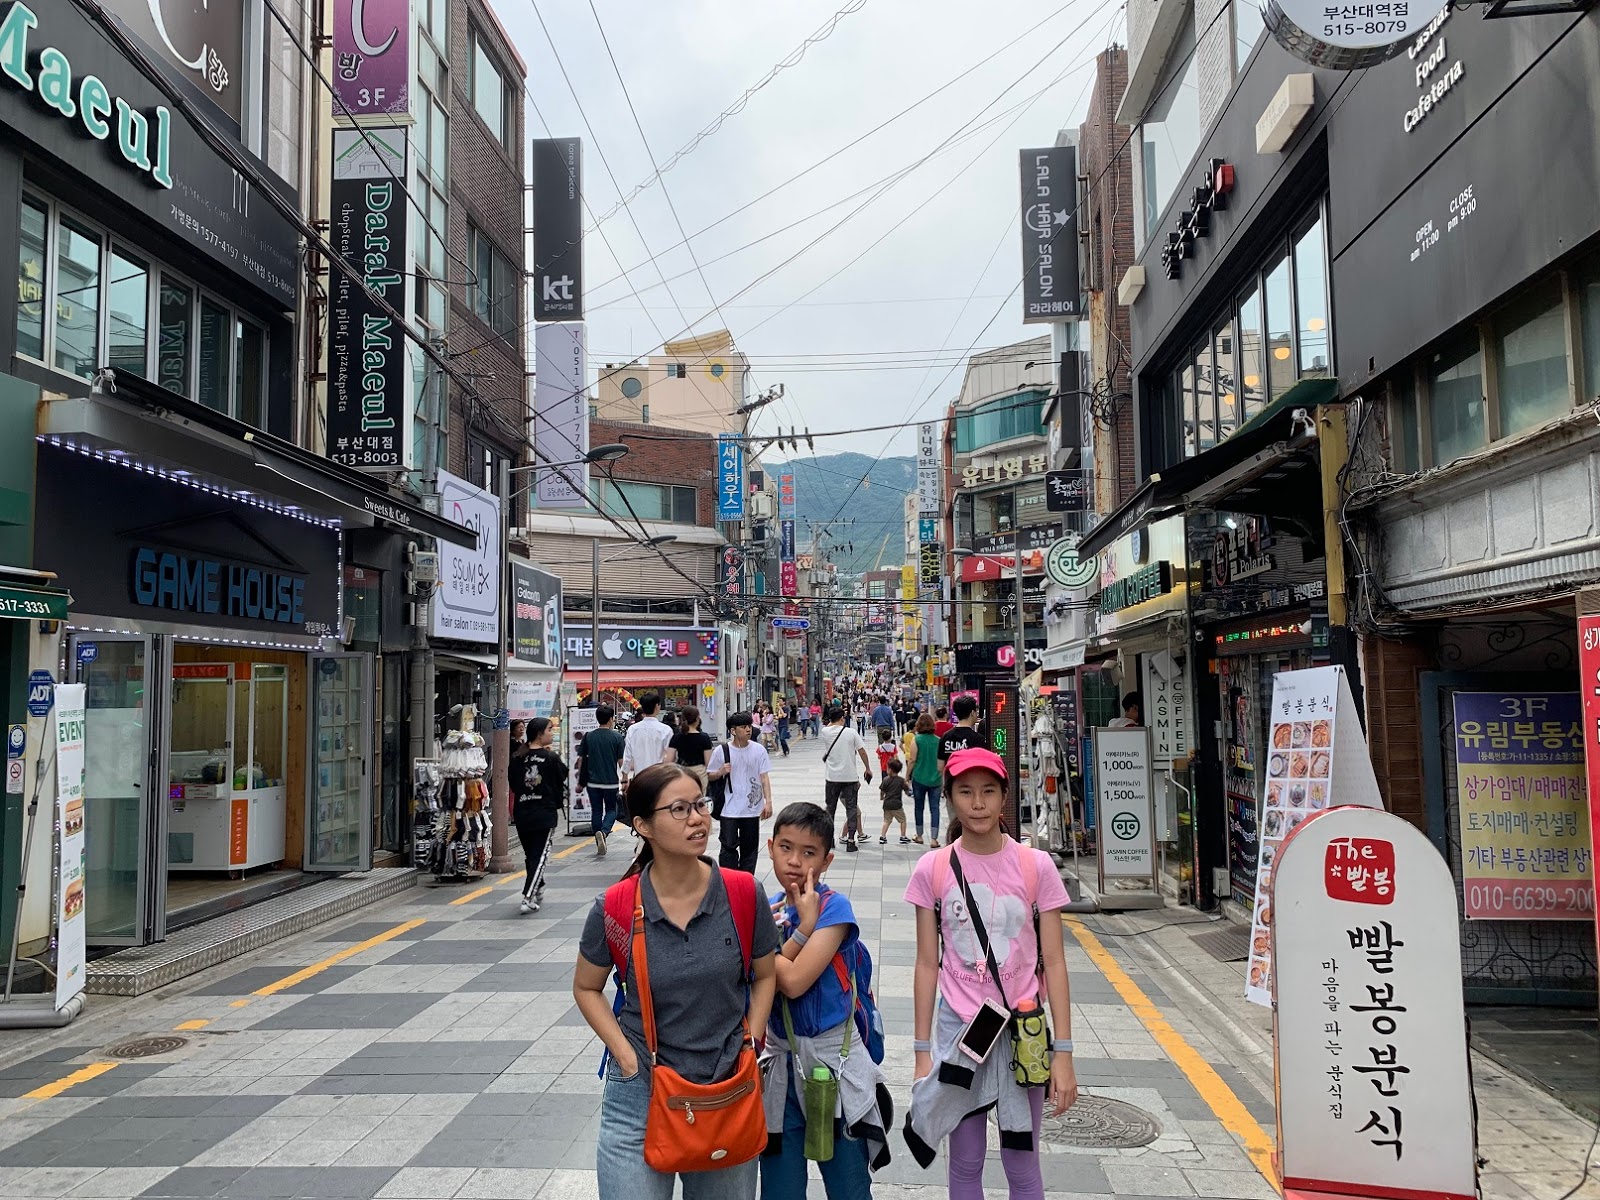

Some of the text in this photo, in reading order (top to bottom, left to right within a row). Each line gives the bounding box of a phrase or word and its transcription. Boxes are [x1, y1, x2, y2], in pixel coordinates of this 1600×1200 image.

[1323, 4, 1409, 20] 부산대역점
[1323, 21, 1407, 36] 515-8079
[1415, 37, 1447, 87] Food
[357, 87, 386, 107] 3F
[1403, 60, 1465, 132] Cafeteria
[1449, 184, 1473, 213] CLOSE
[1036, 155, 1054, 298] LALA HAIR SALON
[1447, 197, 1477, 233] pm 9:00
[1415, 219, 1433, 243] OPEN
[1421, 228, 1440, 252] 11:00
[170, 204, 200, 234] 가맹문의
[200, 225, 239, 260] 1577-4197
[242, 253, 266, 280] 부산대점
[267, 271, 296, 299] 513-8003
[543, 274, 574, 300] kt
[360, 181, 403, 432] Darak Maeul
[1029, 300, 1073, 314] 라라헤어
[335, 344, 349, 413] pizza&pasta
[336, 436, 394, 450] 부산대점
[331, 452, 398, 465] 513-8003
[961, 455, 1023, 488] 유나영
[364, 496, 411, 526] Sweets & Cafe
[1240, 552, 1271, 572] Polaris
[134, 547, 306, 624] GAME HOUSE
[0, 598, 51, 614] 517-3331
[441, 613, 454, 629] hair
[454, 616, 469, 631] salon
[81, 648, 96, 657] ADT
[627, 638, 673, 658] 아울렛
[28, 685, 52, 702] ADT
[1156, 681, 1170, 752] JASMIN
[1499, 697, 1549, 718] 3F
[59, 720, 85, 743] EVENT
[1464, 774, 1587, 801] 상가임대/매매전
[1327, 840, 1378, 860] The
[1468, 846, 1497, 871] 기타
[1500, 847, 1570, 874] 부동산관련
[1346, 865, 1392, 896] 빨봉
[1320, 957, 1345, 1120] 마음을 파는 분식집
[1346, 919, 1411, 1162] 빨봉분식
